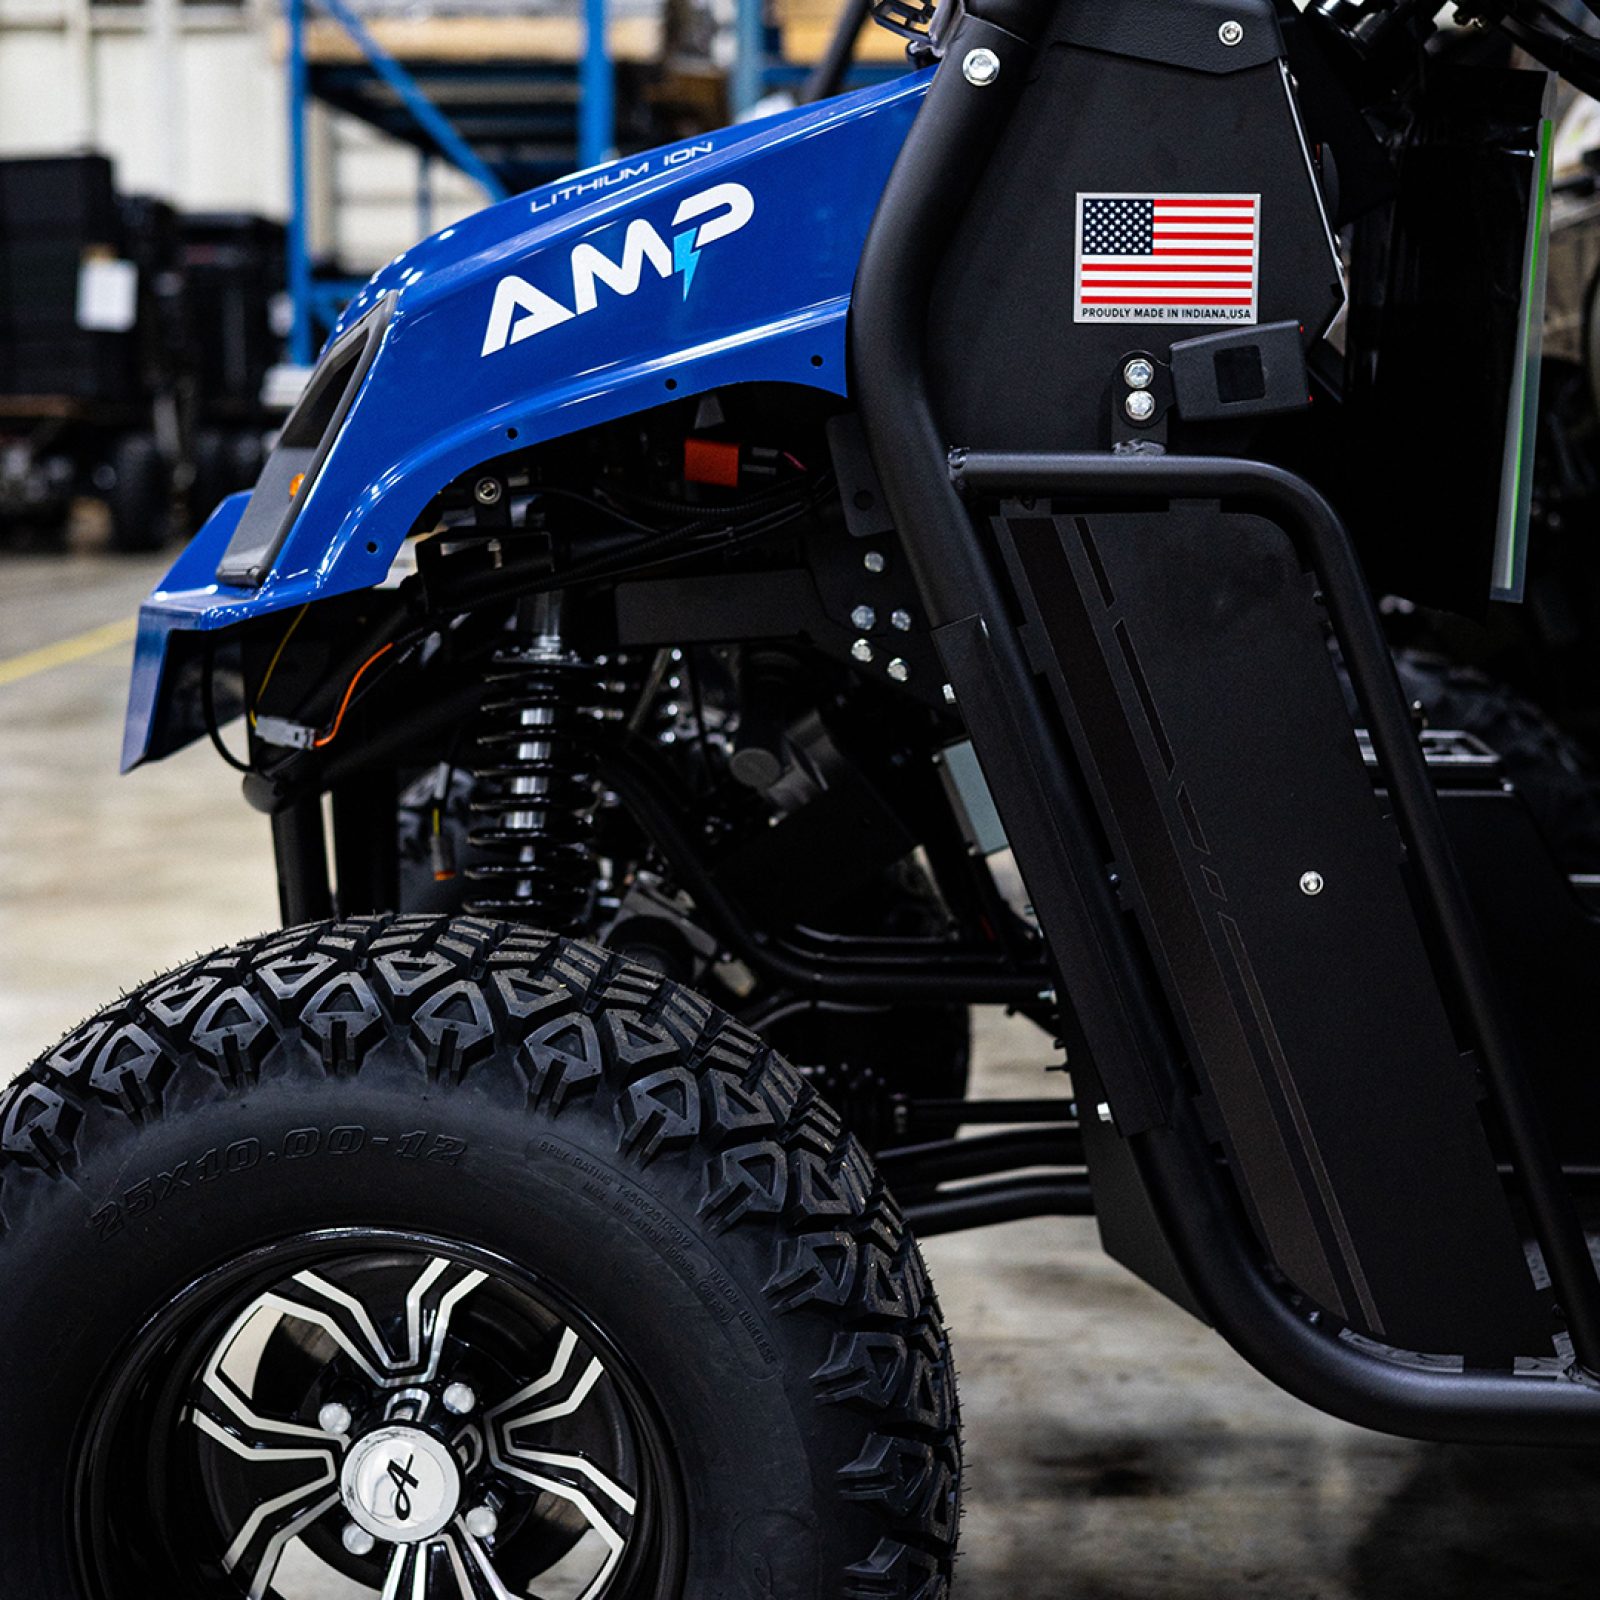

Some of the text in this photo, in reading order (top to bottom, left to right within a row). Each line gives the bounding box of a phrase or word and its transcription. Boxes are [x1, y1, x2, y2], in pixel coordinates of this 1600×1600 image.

[530, 141, 715, 214] LITHIUM ION
[480, 182, 755, 358] AMP
[1082, 307, 1252, 320] PROUDLY MADE IN INDIANA,USA
[572, 1155, 612, 1186] RATING
